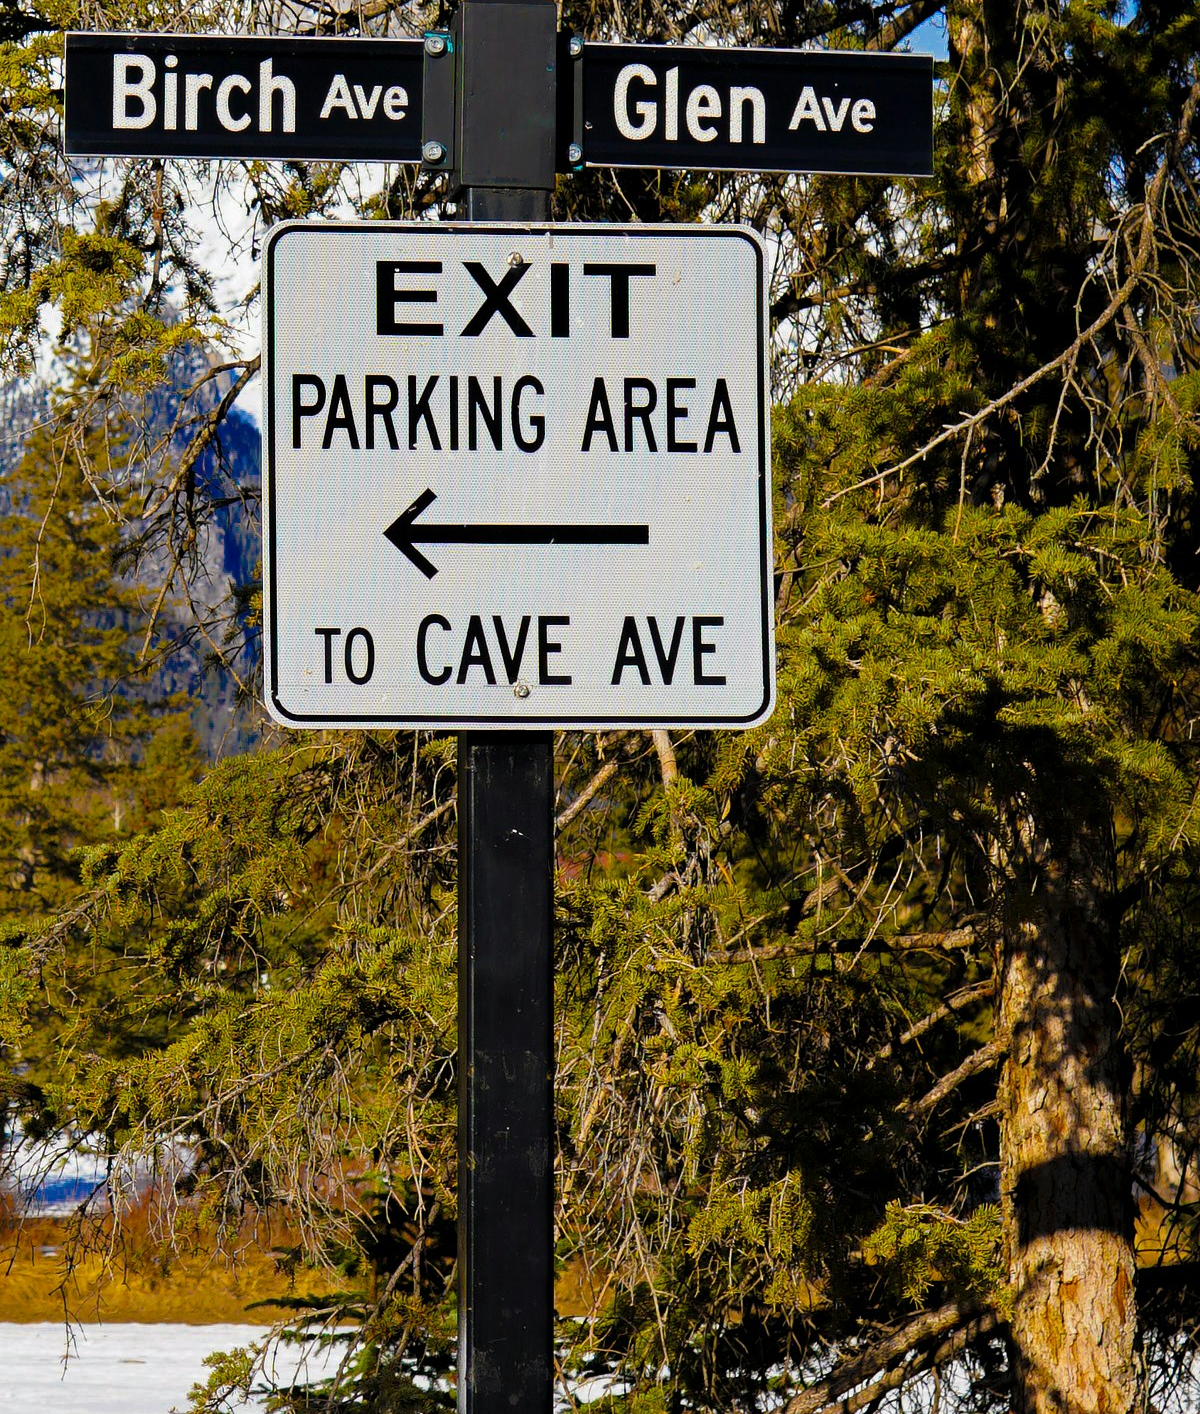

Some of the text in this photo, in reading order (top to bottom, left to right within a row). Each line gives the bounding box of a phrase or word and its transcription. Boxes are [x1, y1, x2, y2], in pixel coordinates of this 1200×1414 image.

[113, 54, 408, 132] Birch Ave
[614, 64, 875, 143] Glen Ave
[377, 259, 656, 338] EXIT
[293, 374, 740, 453] PARKING AREA
[315, 614, 726, 685] TO CAVE AVE
